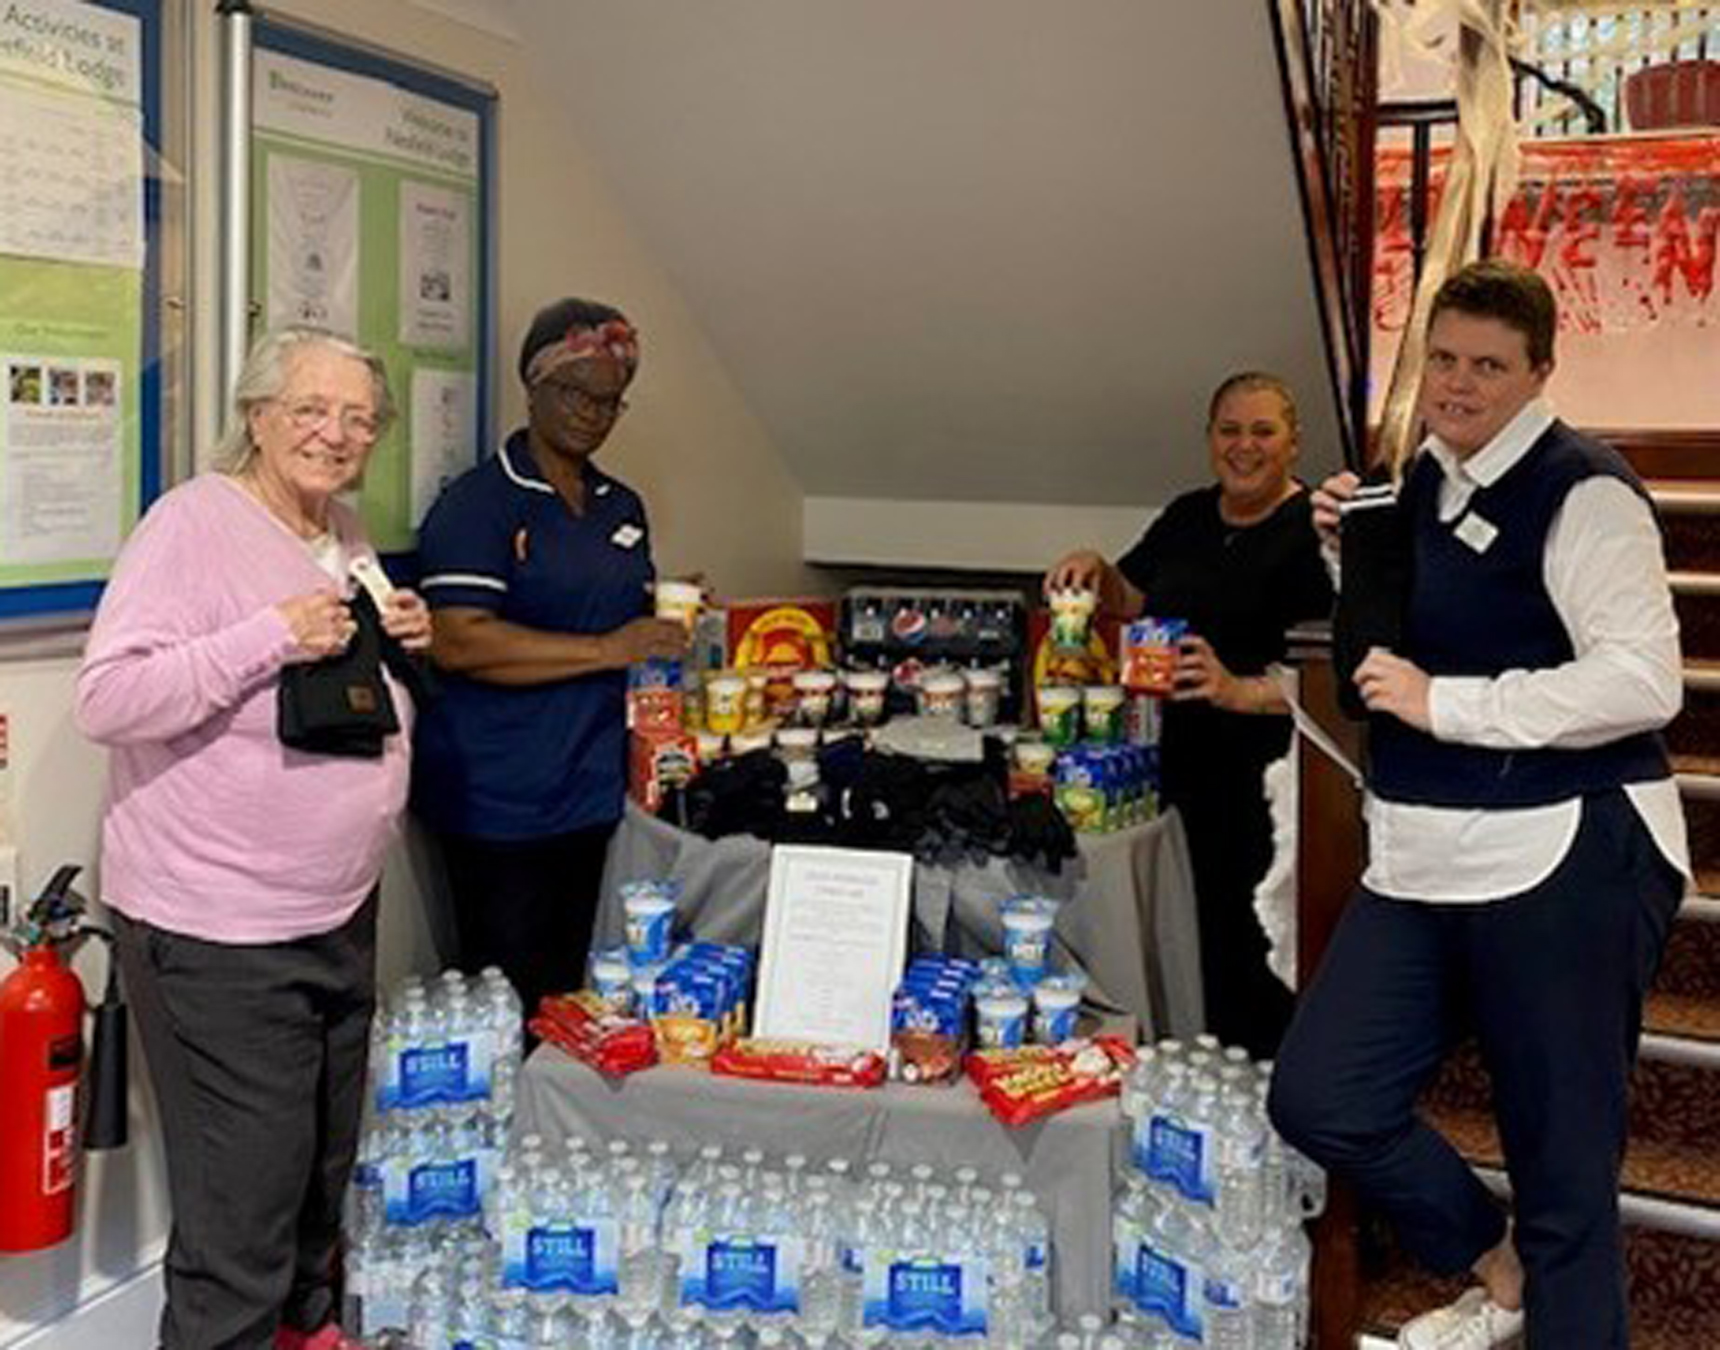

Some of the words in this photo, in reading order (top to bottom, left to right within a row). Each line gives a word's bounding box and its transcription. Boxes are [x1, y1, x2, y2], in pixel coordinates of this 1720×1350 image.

[404, 1051, 462, 1075] STILL
[532, 1235, 588, 1258] STILL
[711, 1251, 770, 1274] STILL
[895, 1271, 956, 1296] STILL
